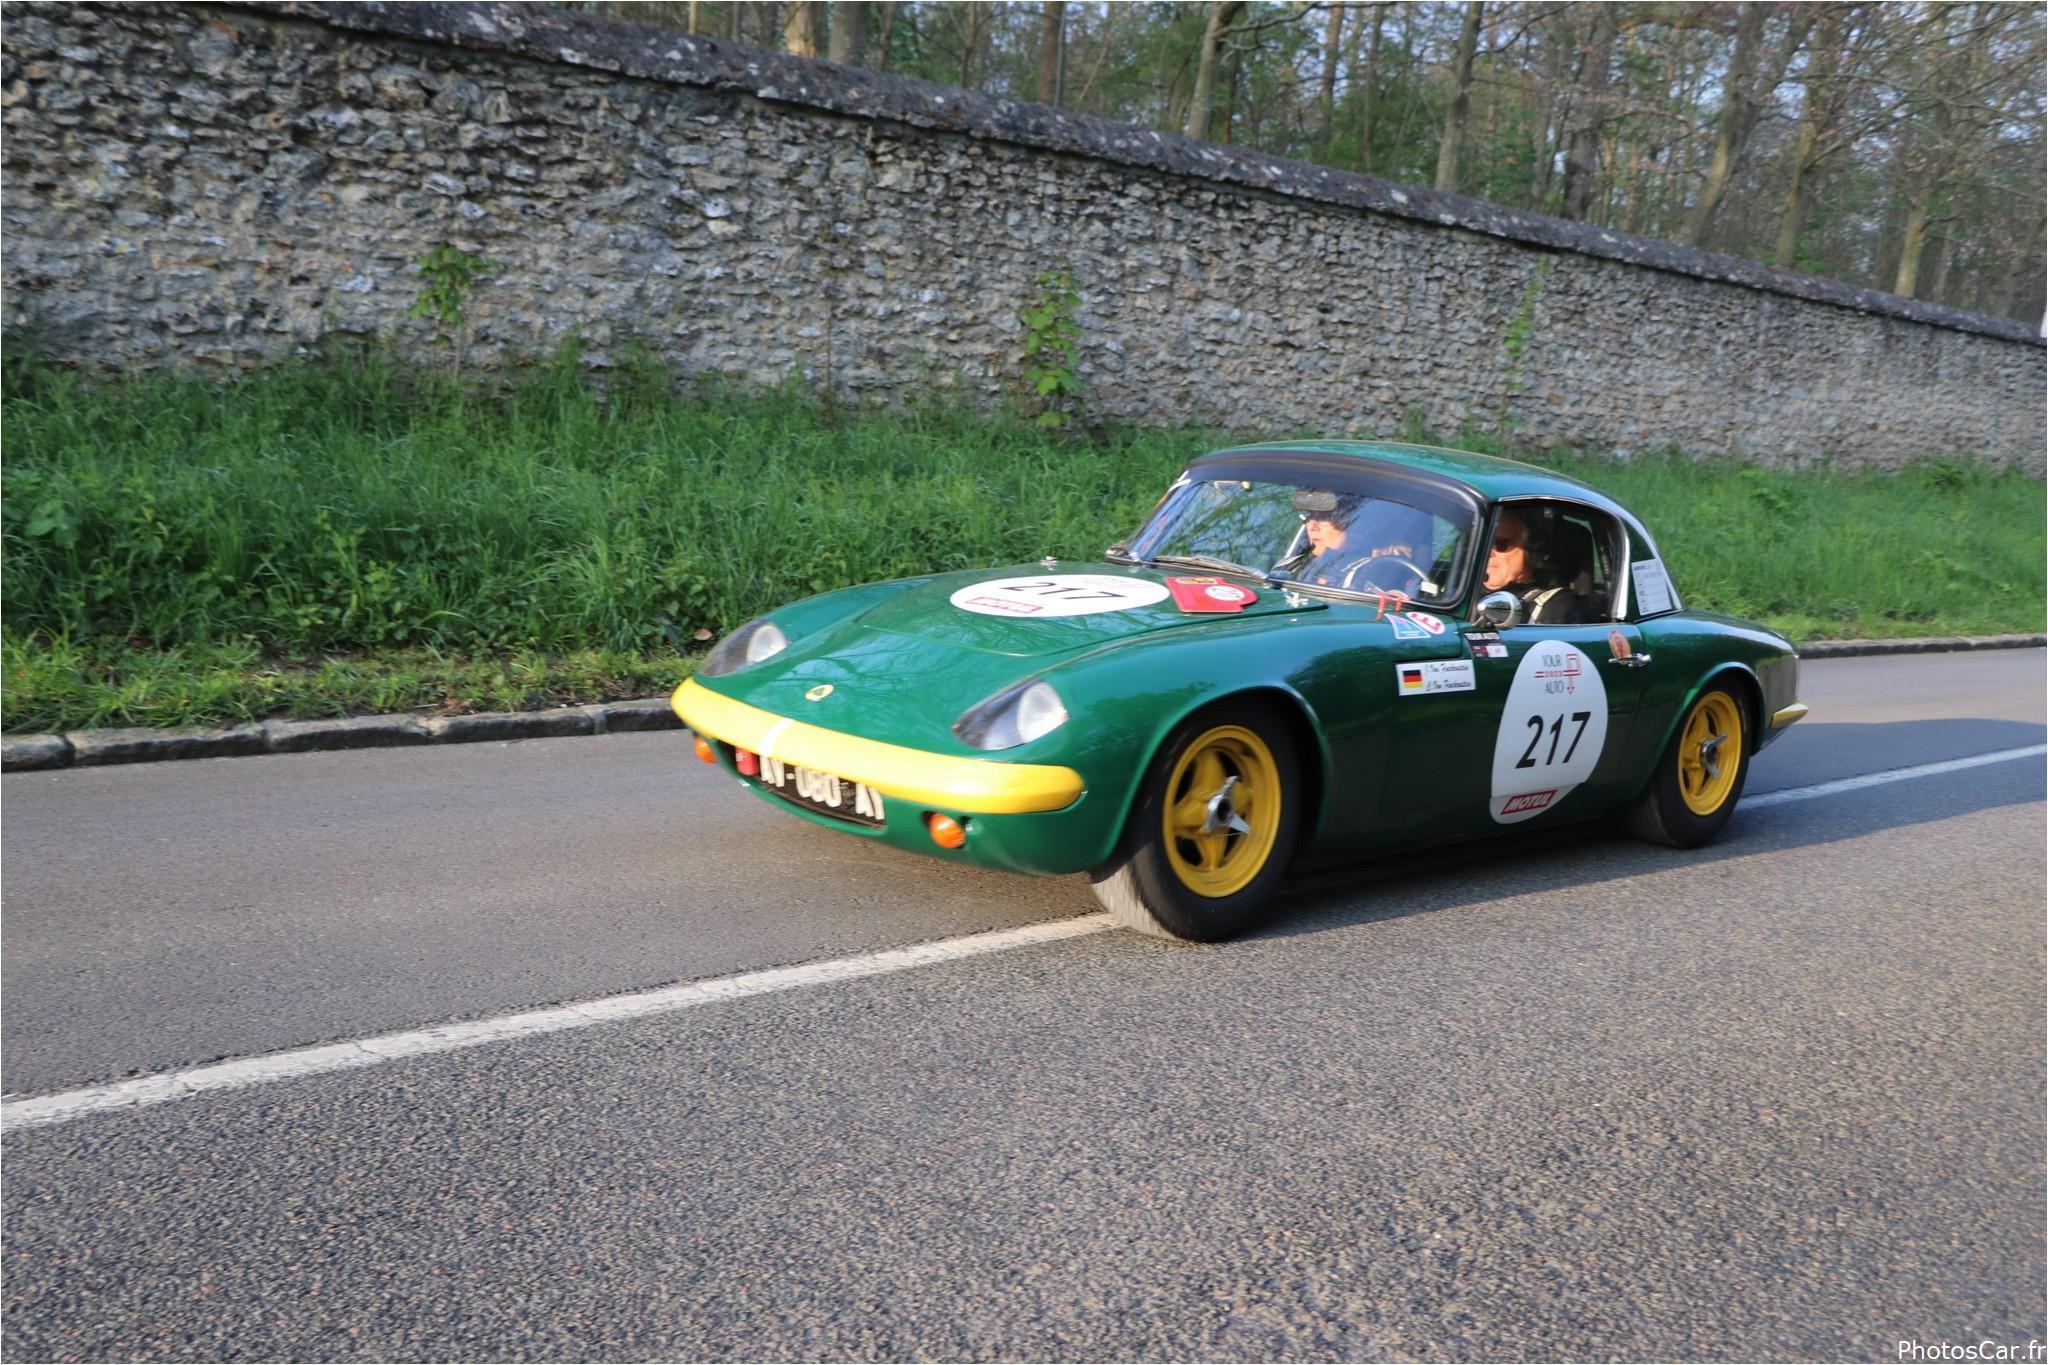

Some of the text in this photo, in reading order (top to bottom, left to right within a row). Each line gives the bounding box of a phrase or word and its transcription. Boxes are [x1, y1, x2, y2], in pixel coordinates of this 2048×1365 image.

[1001, 581, 1128, 600] 217
[1541, 654, 1562, 667] TOUR
[1544, 680, 1565, 694] AUTO
[1515, 711, 1592, 769] 217
[1503, 791, 1555, 813] MOTUL
